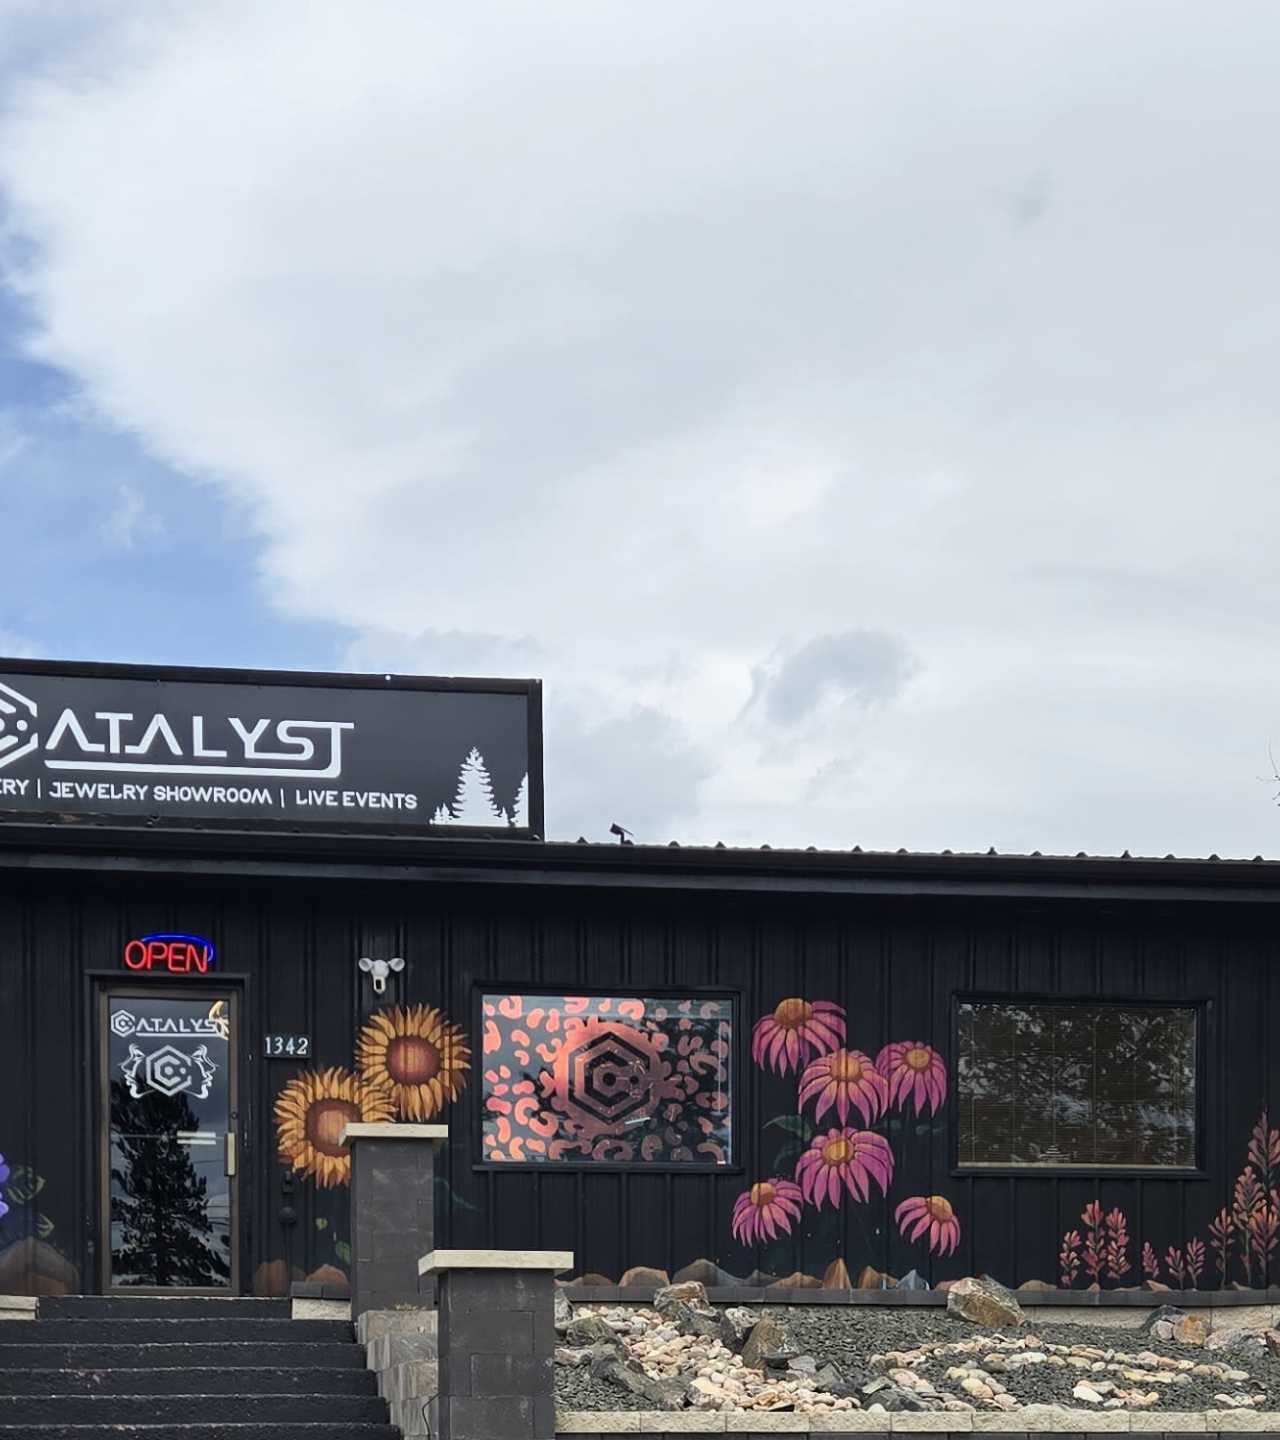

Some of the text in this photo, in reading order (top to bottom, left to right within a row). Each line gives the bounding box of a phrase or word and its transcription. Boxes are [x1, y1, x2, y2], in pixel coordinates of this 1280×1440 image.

[49, 782, 148, 801] JEWELRY
[153, 785, 273, 804] SHOWROOM
[296, 790, 338, 806] LIVE
[342, 791, 418, 809] EVENTS
[124, 940, 209, 973] OPEN
[265, 1037, 309, 1055] 1342
